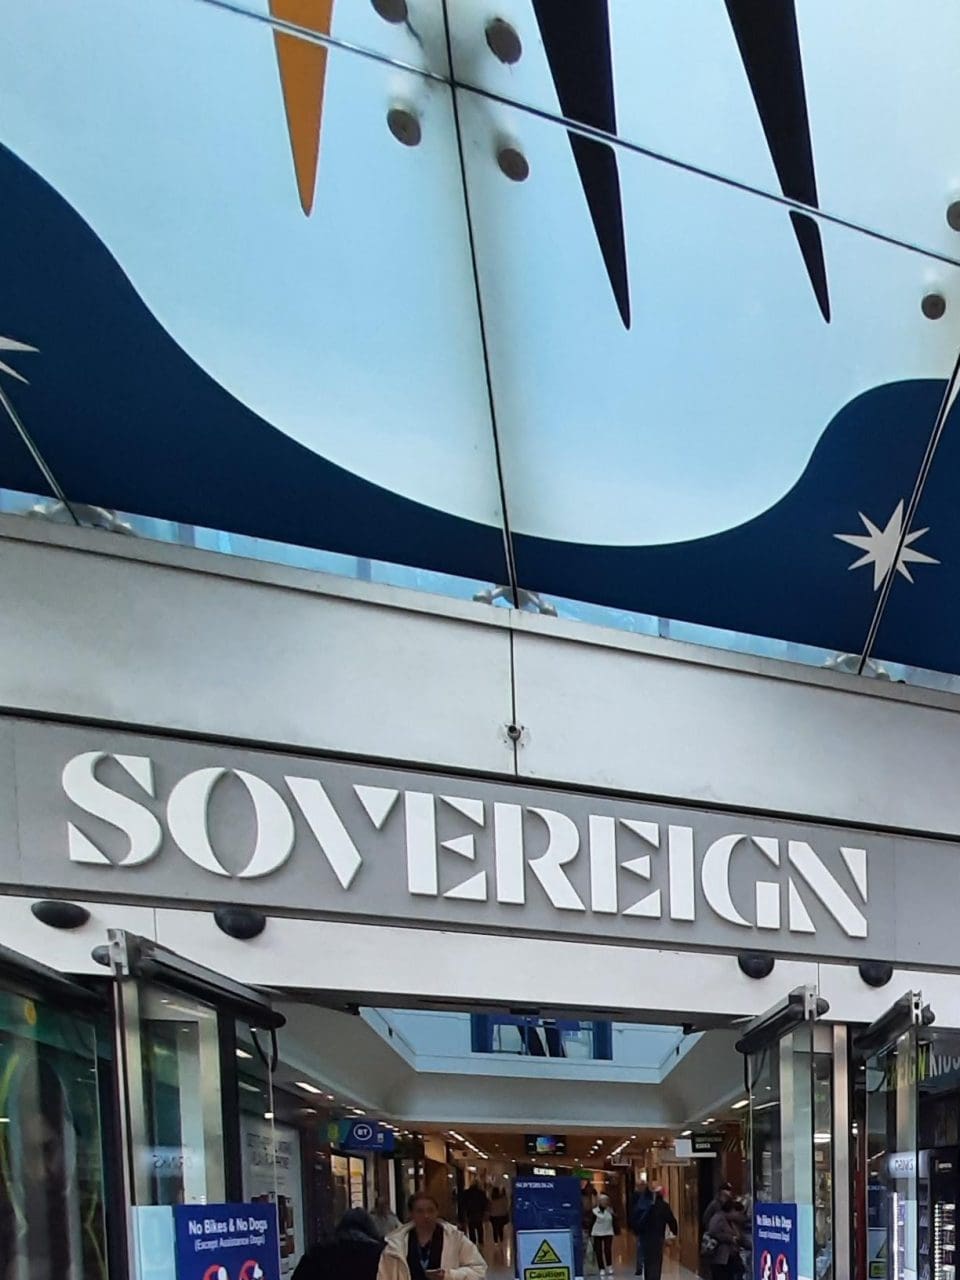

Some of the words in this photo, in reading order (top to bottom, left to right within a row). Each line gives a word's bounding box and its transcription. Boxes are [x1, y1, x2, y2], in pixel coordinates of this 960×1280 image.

[62, 751, 869, 939] SOVEREIGN
[188, 1220, 202, 1235] No
[204, 1219, 227, 1234] Bikes
[229, 1218, 235, 1232] &
[236, 1218, 248, 1231] No
[249, 1217, 268, 1233] Dogs
[529, 1270, 565, 1279] Caution
